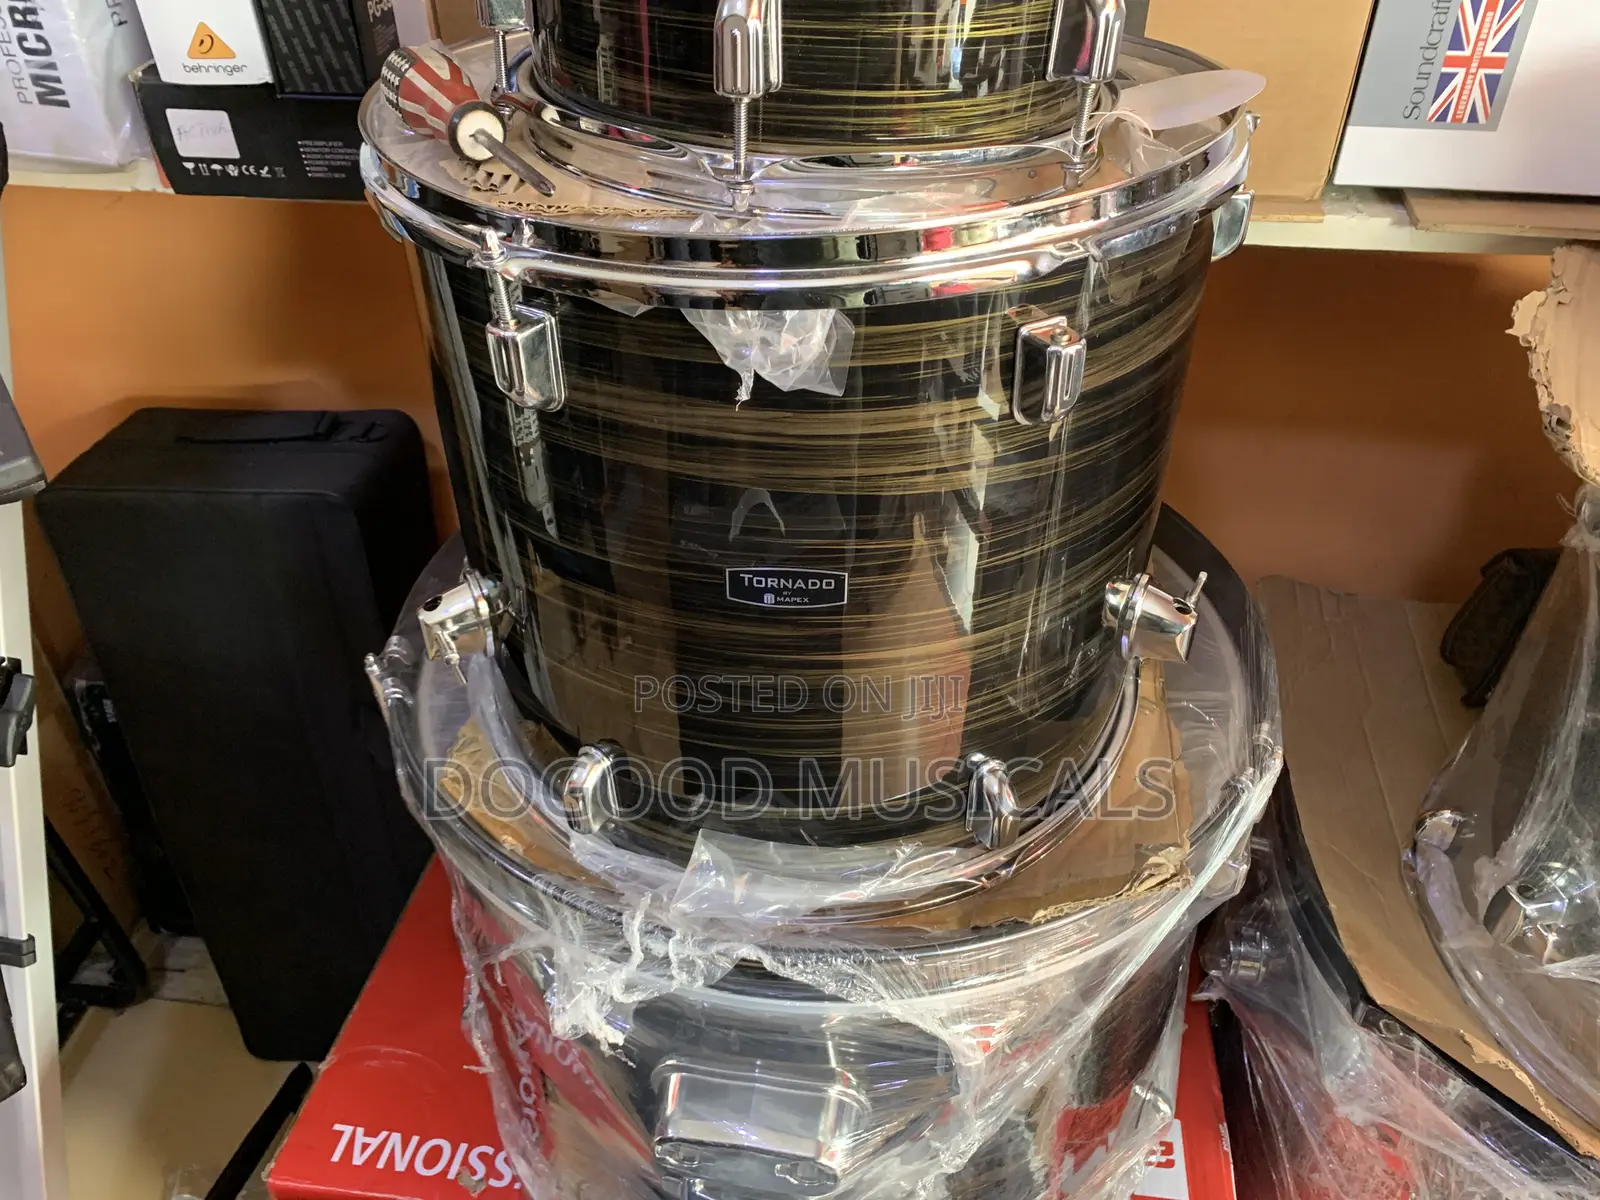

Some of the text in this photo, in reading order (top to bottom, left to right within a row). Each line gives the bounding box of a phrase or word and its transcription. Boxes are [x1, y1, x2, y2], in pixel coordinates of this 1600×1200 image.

[181, 62, 249, 77] behringer
[1402, 0, 1453, 121] Soundcraft
[740, 574, 835, 589] TORNADO
[330, 1123, 522, 1190] SSIONAL
